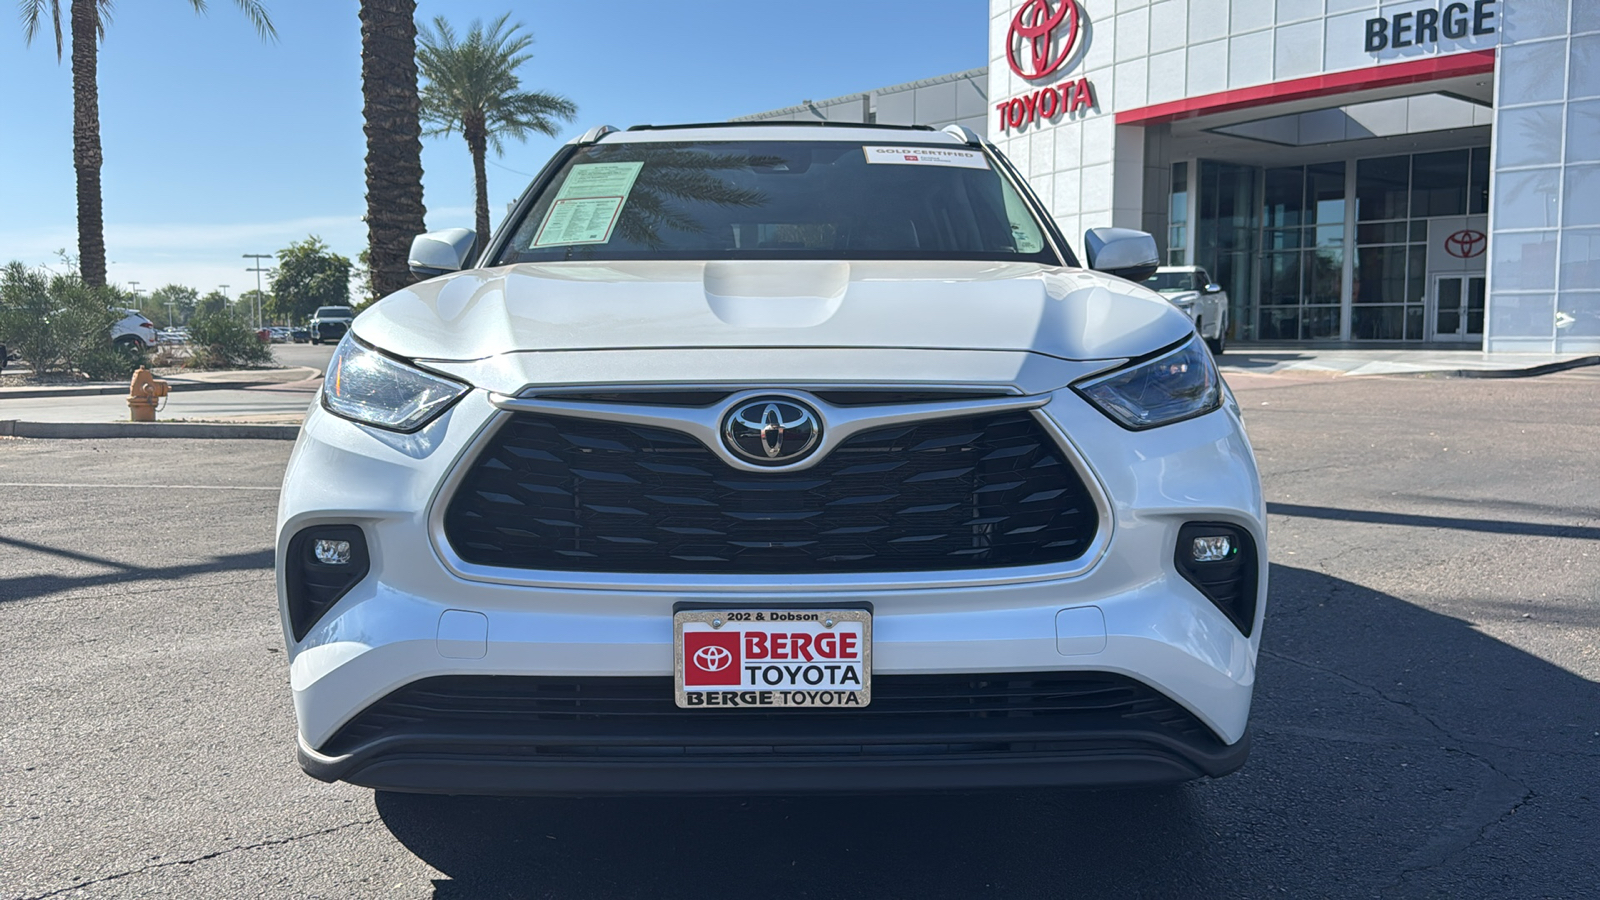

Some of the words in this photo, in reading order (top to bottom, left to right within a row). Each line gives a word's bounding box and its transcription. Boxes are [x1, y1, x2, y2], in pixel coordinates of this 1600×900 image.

[1364, 0, 1497, 53] BERGE
[996, 77, 1093, 132] TOYOTA
[913, 149, 974, 158] CERTIFIED
[727, 612, 751, 621] 202
[755, 612, 765, 621] &
[770, 612, 819, 621] Dobson
[744, 631, 859, 662] BERGE
[744, 665, 861, 685] TOYOTA
[686, 691, 774, 706] BERGE
[780, 690, 860, 705] TOYOTA
